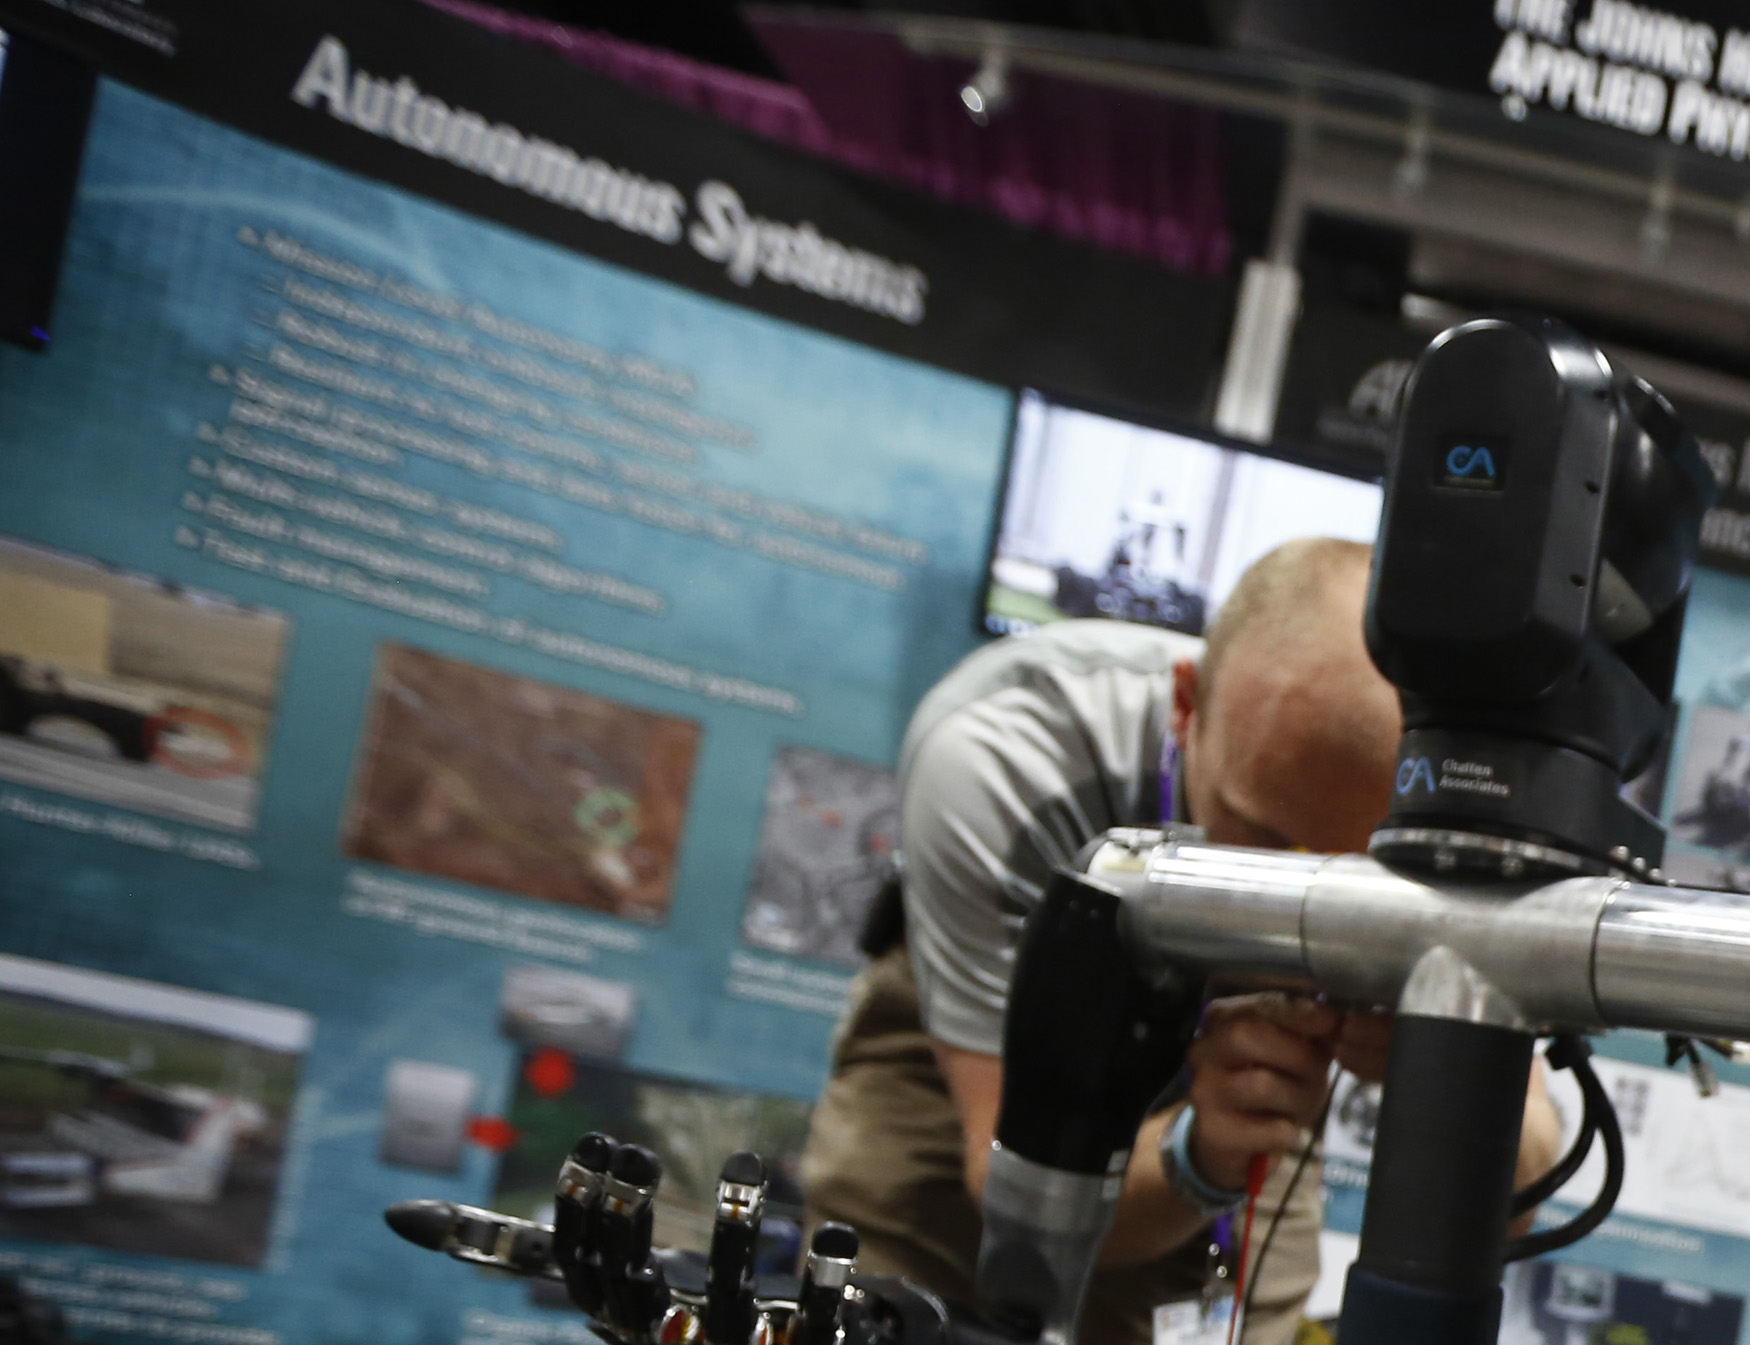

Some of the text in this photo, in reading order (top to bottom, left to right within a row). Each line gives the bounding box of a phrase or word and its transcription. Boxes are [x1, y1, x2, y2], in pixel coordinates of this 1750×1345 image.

[1489, 28, 1667, 136] APPLIED
[1575, 0, 1718, 83] JOHNS
[291, 34, 687, 244] Autonomous
[689, 180, 927, 325] Systems
[1439, 774, 1511, 798] Associates
